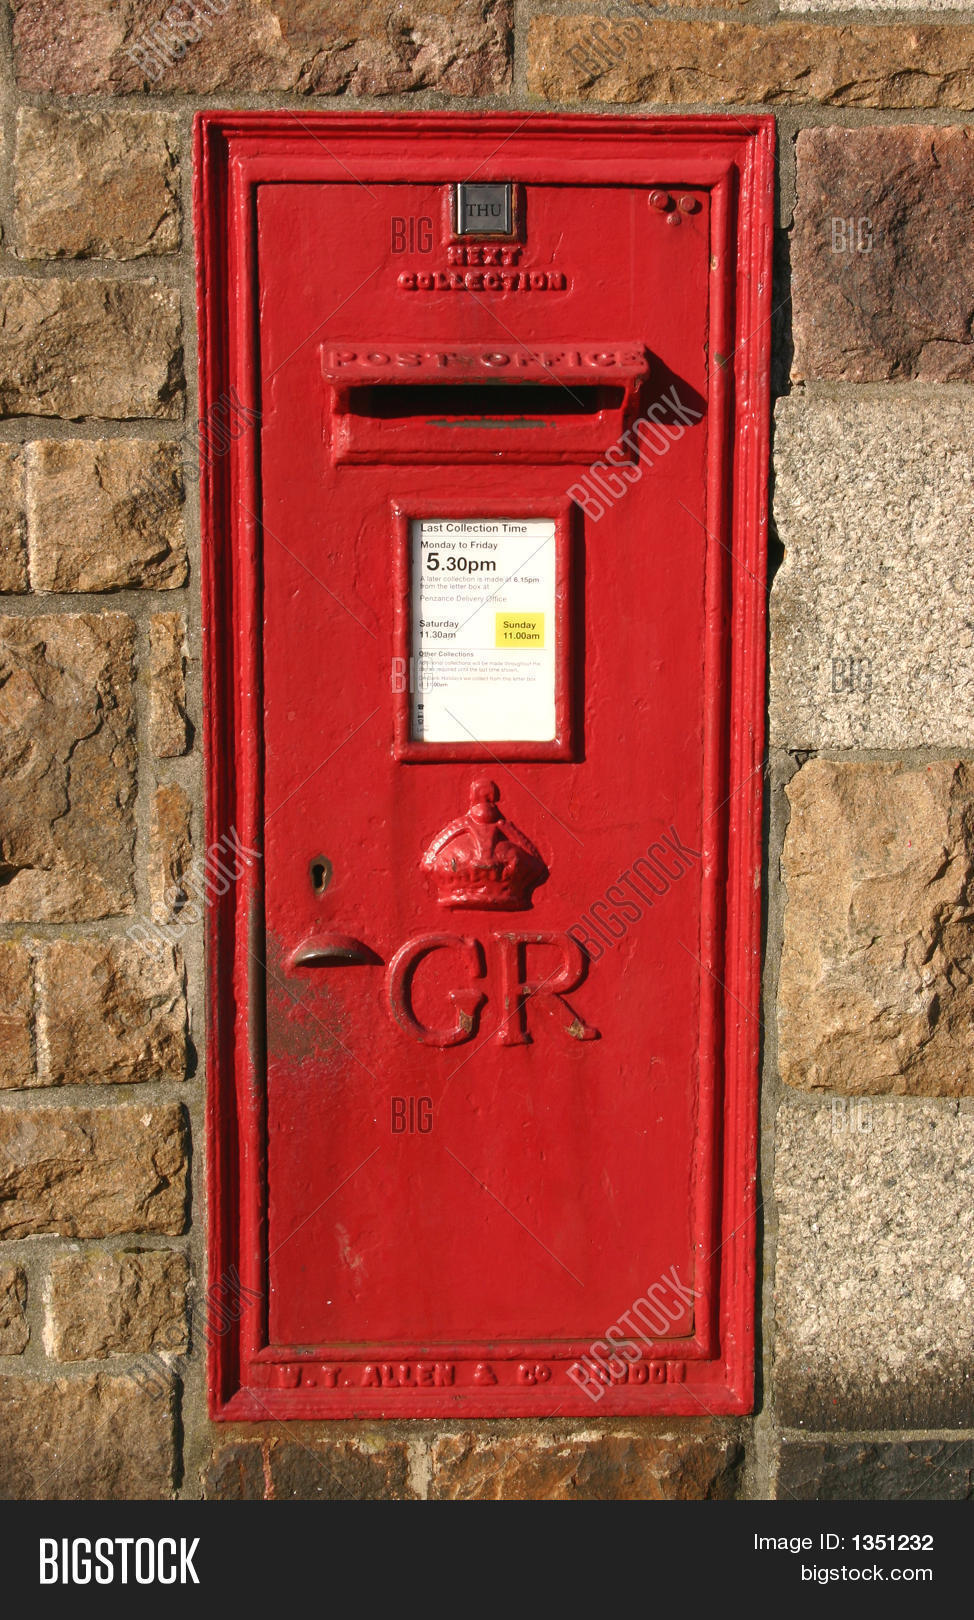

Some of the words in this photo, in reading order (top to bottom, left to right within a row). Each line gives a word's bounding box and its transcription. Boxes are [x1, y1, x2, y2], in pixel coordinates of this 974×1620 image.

[465, 203, 502, 217] THU
[447, 247, 521, 266] NEXT
[398, 271, 567, 291] COLLECTION
[328, 351, 448, 368] POST
[480, 351, 645, 369] OFFICE
[420, 523, 443, 533] Last
[446, 523, 499, 533] Collection
[502, 523, 527, 533] Time
[420, 541, 456, 550] Monday
[459, 541, 468, 549] to
[470, 541, 498, 550] Friday
[426, 552, 496, 574] 5.30pm
[420, 594, 454, 602] Penzance
[456, 594, 484, 603] Delivery
[419, 620, 460, 629] Saturday
[503, 621, 537, 631] Sunday
[419, 630, 457, 639] 11.30am
[503, 632, 540, 640] 11.00am
[384, 931, 602, 1049] GR
[361, 1364, 456, 1387] ALLEN
